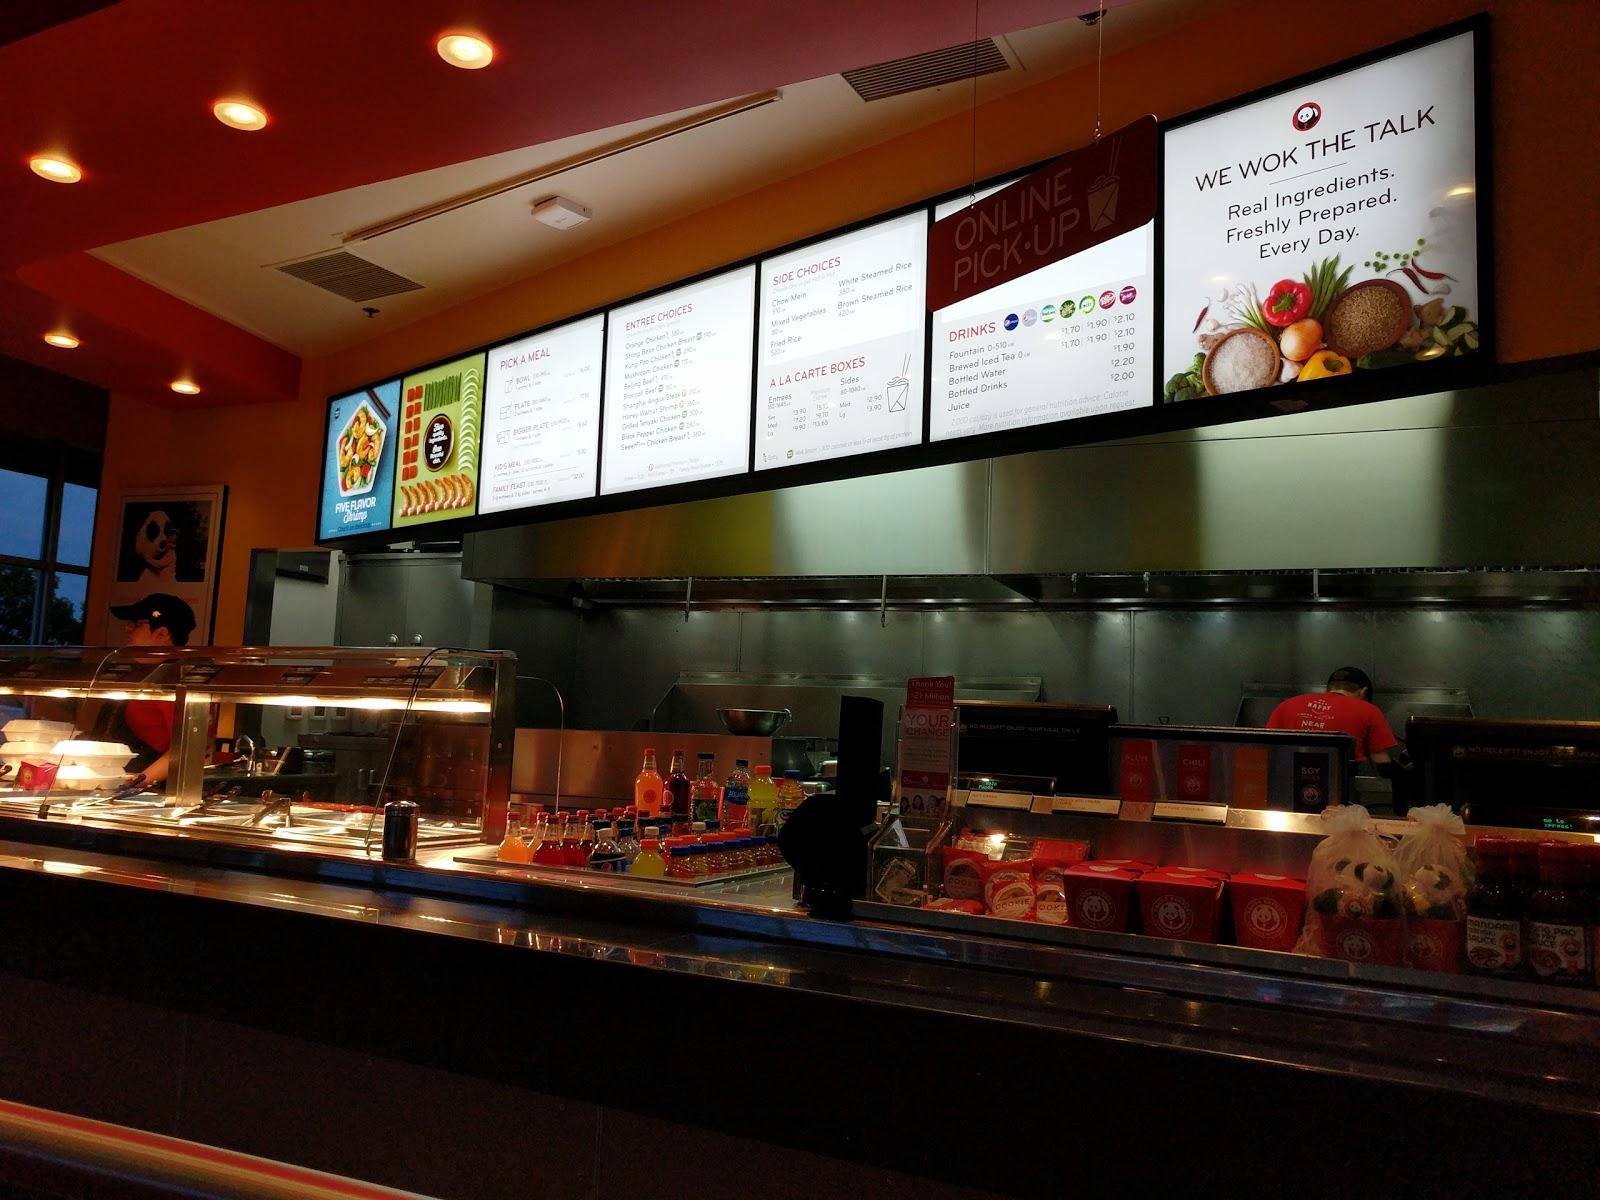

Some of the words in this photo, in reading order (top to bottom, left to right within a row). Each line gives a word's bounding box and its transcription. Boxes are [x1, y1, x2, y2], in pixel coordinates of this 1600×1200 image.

[1195, 166, 1232, 192] WE
[1238, 147, 1298, 180] WOK
[1305, 130, 1356, 160] THE
[1364, 105, 1436, 143] TALK
[1228, 197, 1268, 220] Real
[1276, 166, 1395, 208] Ingredients.
[954, 167, 1073, 250] ONLINE
[1226, 217, 1291, 244] Freshly
[1299, 188, 1397, 225] Prepared.
[1259, 237, 1310, 259] Every
[1318, 226, 1360, 245] Day.
[773, 271, 794, 286] SIDE
[796, 257, 841, 278] CHOICES
[838, 278, 859, 288] White
[861, 267, 893, 282] Steamed
[895, 262, 912, 271] Rice
[771, 296, 789, 307] Chow
[791, 292, 807, 302] Mein
[837, 299, 859, 310] Brown
[861, 289, 894, 303] Steamed
[896, 284, 913, 293] Rice
[626, 315, 655, 331] ENTREE
[657, 303, 693, 322] CHOICES
[771, 317, 790, 328] Mixed
[791, 307, 827, 323] Vegetables
[770, 340, 786, 349] Fried
[787, 335, 802, 344] Rice
[949, 322, 996, 342] DRINKS
[949, 346, 985, 360] Fountain
[987, 341, 1007, 352] 0-510
[1086, 318, 1107, 330] $1.90
[1114, 312, 1136, 324] $2.10
[625, 340, 644, 350] Orange
[949, 359, 980, 373] Brewed
[981, 356, 1000, 367] Iced
[1002, 353, 1016, 363] Tea
[1086, 333, 1108, 344] $1.90
[1114, 327, 1136, 339] $2.10
[500, 355, 518, 370] PICK
[520, 353, 527, 364] A
[528, 347, 551, 362] MEAL
[949, 373, 979, 386] Bottled
[981, 367, 1007, 382] Water
[1113, 342, 1136, 353] $1.90
[624, 369, 651, 380] Mushroom
[770, 378, 777, 388] A
[779, 375, 791, 386] LA
[794, 366, 827, 382] CARTE
[831, 357, 866, 374] BOXES
[840, 376, 860, 386] Sides
[948, 386, 979, 399] Bottled
[981, 381, 1008, 394] Drinks
[1111, 356, 1136, 367] $2.20
[768, 393, 792, 404] Entrees
[947, 400, 970, 412] Juice
[1110, 371, 1136, 382] $2.00
[647, 436, 668, 446] Chicken
[335, 501, 350, 513] FIVE
[351, 496, 377, 510] FLAVOR
[906, 713, 950, 728] YOUR
[906, 727, 949, 737] CHANGE
[1301, 766, 1321, 776] SOY
[995, 898, 1031, 910] COOKIE
